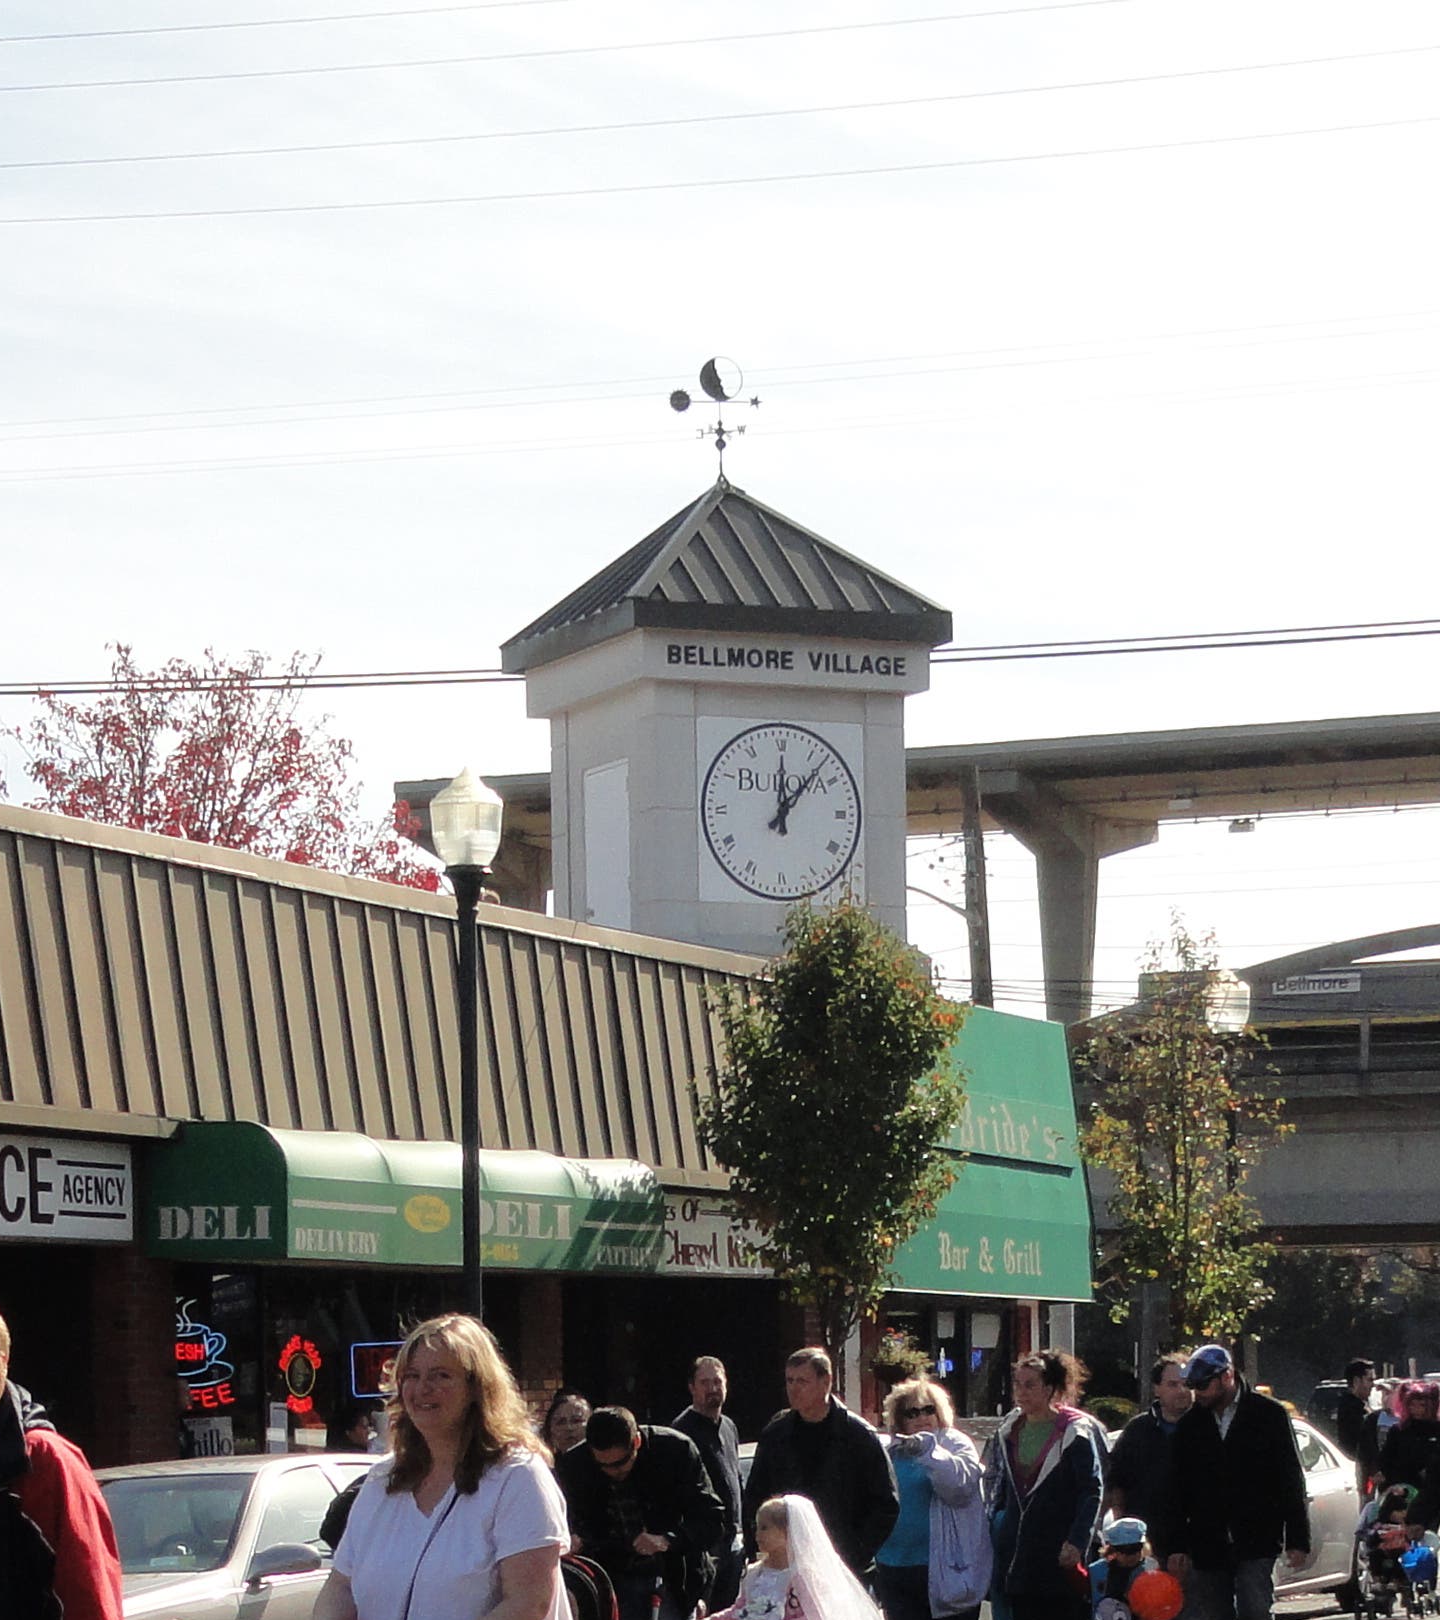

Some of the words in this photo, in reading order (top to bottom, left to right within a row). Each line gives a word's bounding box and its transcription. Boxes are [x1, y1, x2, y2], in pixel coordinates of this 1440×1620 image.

[666, 643, 795, 671] BELLMORE
[808, 651, 907, 677] VILLAGE
[737, 766, 828, 796] BULOVA
[1275, 976, 1349, 993] Bellmore
[62, 1173, 127, 1207] AGENCY
[157, 1205, 272, 1240] DELI
[294, 1227, 381, 1256] DELIVERY
[938, 1231, 970, 1271] Bar
[978, 1236, 996, 1275] &
[1003, 1238, 1043, 1277] Grill
